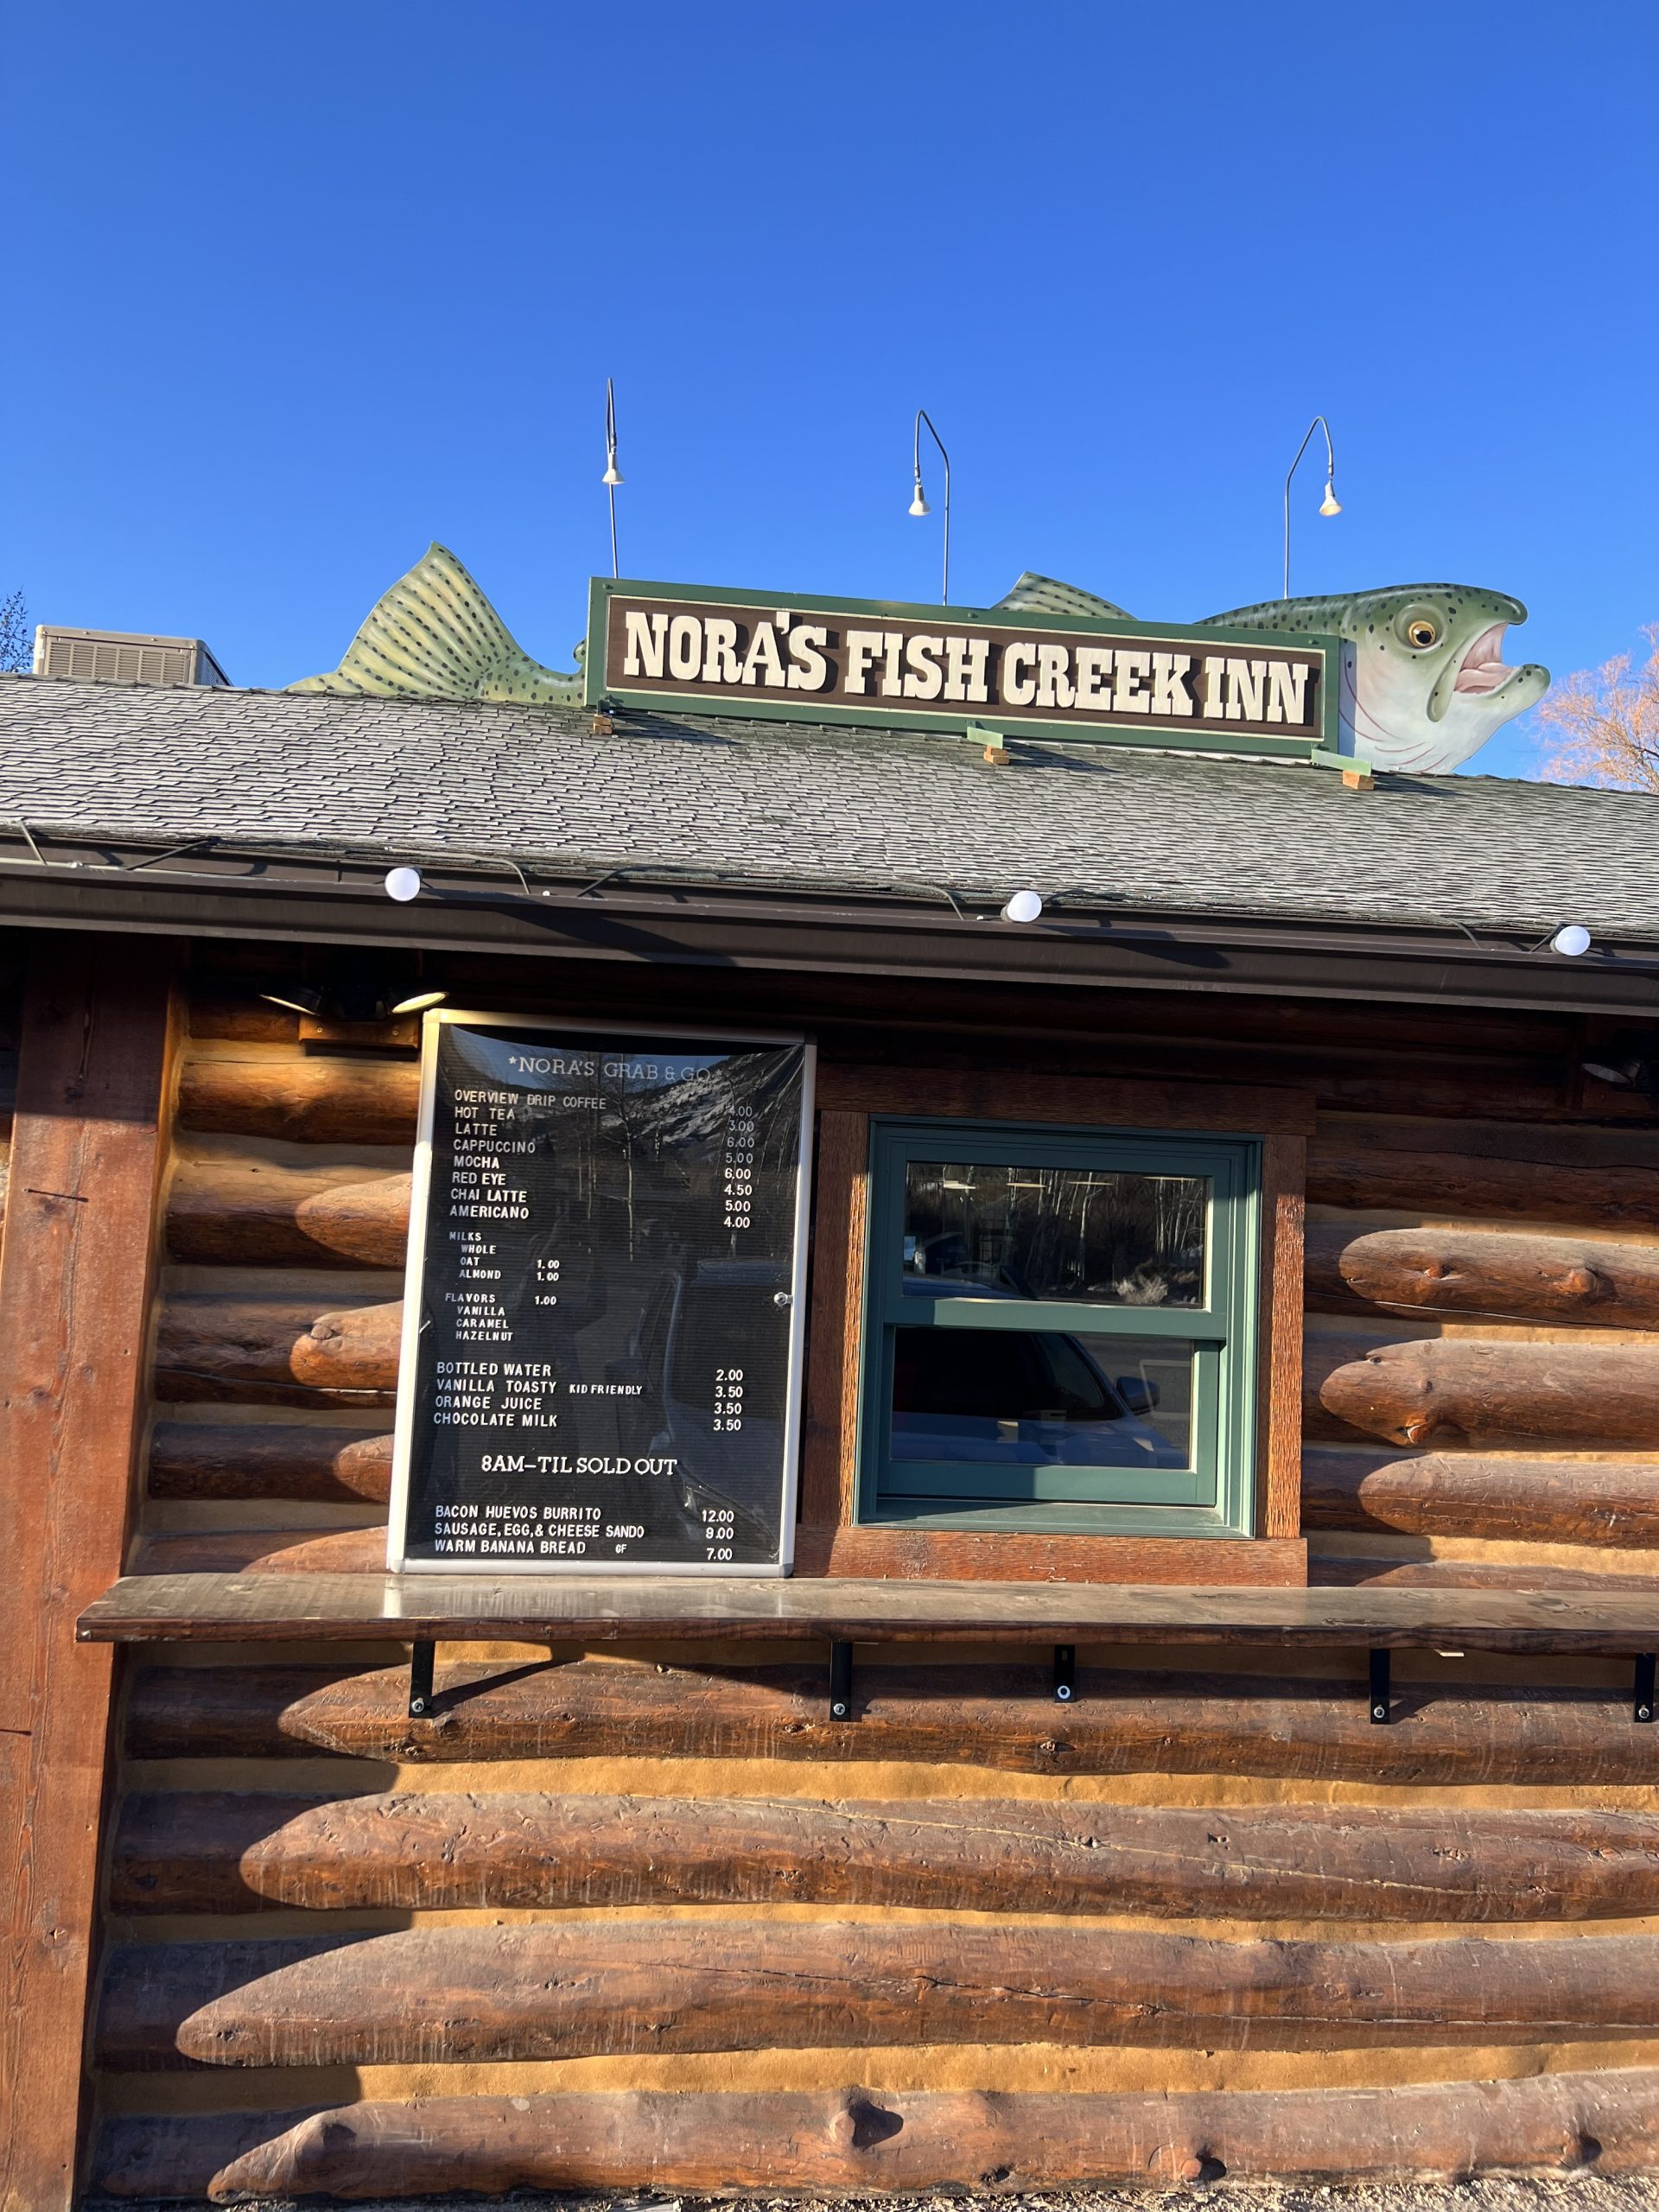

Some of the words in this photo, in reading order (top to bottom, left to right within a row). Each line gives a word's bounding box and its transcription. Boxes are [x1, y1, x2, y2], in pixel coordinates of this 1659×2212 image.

[624, 610, 827, 690] NORA'S
[845, 630, 989, 702] FISH
[1002, 642, 1193, 716] CREEK
[1204, 657, 1309, 724] INN
[518, 1057, 595, 1077] NORA'S
[604, 1062, 658, 1080] GRAB
[664, 1066, 677, 1080] &
[681, 1067, 710, 1083] GO
[454, 1090, 518, 1104] OVERVIEW
[526, 1094, 556, 1107] DRIP
[563, 1096, 607, 1109] COFFEE
[454, 1107, 479, 1119] HOT
[490, 1108, 515, 1120] TEA
[455, 1122, 498, 1136] LATTE
[728, 1120, 754, 1132] 3.00
[454, 1139, 536, 1154] CAPPUCCINO
[727, 1136, 755, 1148] 6.00
[454, 1155, 500, 1169] MOCHA
[725, 1152, 753, 1164] 5.00
[452, 1172, 478, 1184] RED
[481, 1173, 507, 1185] EYE
[724, 1167, 752, 1180] 6.00
[450, 1188, 480, 1201] CHAI
[486, 1190, 527, 1203] LATTE
[724, 1184, 753, 1197] 4.50
[449, 1205, 530, 1219] AMERICANO
[724, 1200, 751, 1212] 5.00
[723, 1216, 751, 1229] 4.00
[449, 1231, 482, 1242] MILKS
[461, 1244, 497, 1255] WHOLE
[460, 1256, 480, 1267] OAT
[537, 1259, 560, 1269] 1.00
[459, 1269, 502, 1280] ALMOND
[537, 1272, 560, 1281] 1.00
[445, 1293, 496, 1304] FLAVORS
[534, 1296, 557, 1306] 1.00
[457, 1306, 505, 1316] VANILLA
[456, 1319, 510, 1329] CARAMEL
[455, 1332, 513, 1342] HAZELNUT
[436, 1362, 499, 1376] BOTTLED
[504, 1363, 551, 1376] WATER
[715, 1369, 744, 1382] 2.00
[436, 1378, 495, 1392] VANILLA
[505, 1381, 556, 1394] TOASTY
[569, 1383, 588, 1394] KID
[590, 1384, 642, 1395] FRIENDLY
[715, 1386, 743, 1398] 3.50
[435, 1395, 491, 1408] ORANGE
[501, 1397, 543, 1410] JUICE
[713, 1402, 742, 1415] 3.50
[434, 1412, 515, 1427] CHOCOLATE
[522, 1414, 558, 1427] MILK
[713, 1419, 741, 1432] 3.50
[576, 1457, 632, 1475] SOLD
[634, 1458, 678, 1476] OUT
[435, 1505, 479, 1518] BACON
[486, 1506, 537, 1519] HUEVOS
[543, 1507, 601, 1521] BURRITO
[702, 1509, 734, 1522] 12.00
[548, 1524, 600, 1538] CHEESE
[606, 1526, 645, 1539] SANDO
[705, 1527, 734, 1540] 9.00
[435, 1539, 476, 1553] WARM
[480, 1541, 535, 1554] BANANA
[540, 1541, 586, 1554] BREAD
[615, 1544, 627, 1554] GF
[706, 1547, 733, 1560] 7.00
